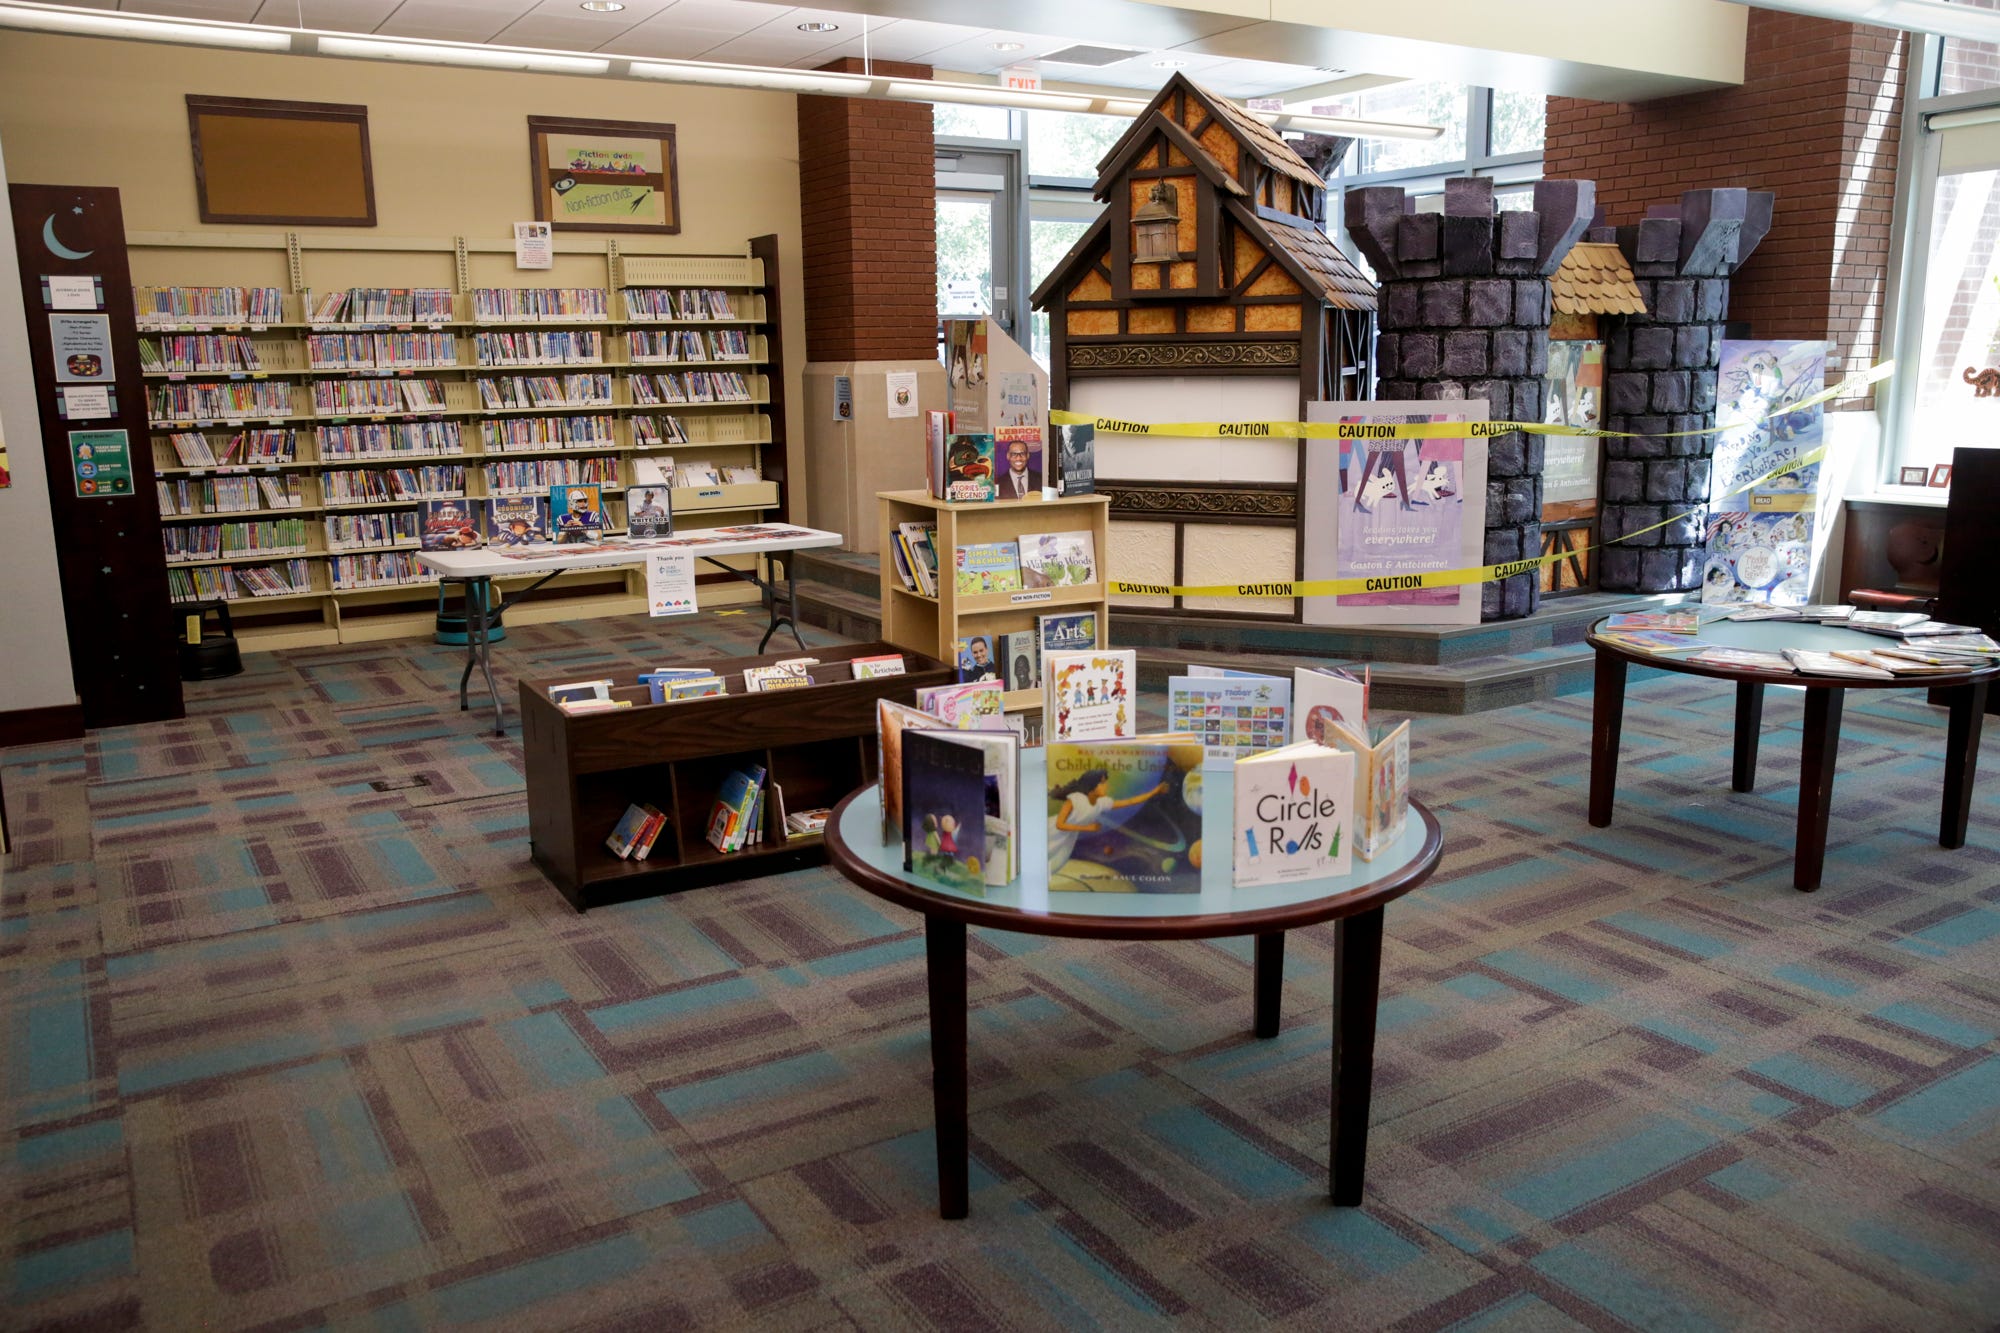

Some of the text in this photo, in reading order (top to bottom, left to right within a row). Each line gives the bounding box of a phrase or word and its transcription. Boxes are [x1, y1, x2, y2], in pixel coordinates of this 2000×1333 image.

[578, 149, 632, 160] Fiction dvds
[1096, 418, 1150, 434] CAUTION
[1218, 423, 1269, 436] CAUTION
[1338, 425, 1396, 439] CAUTION
[1471, 423, 1523, 436] CAUTION
[951, 484, 979, 492] STORIES
[956, 491, 987, 499] LEGENDS
[491, 511, 539, 524] HOCKEY
[1363, 526, 1395, 536] Reading
[1422, 527, 1438, 535] you
[1364, 534, 1436, 546] everywhere!
[967, 548, 998, 558] SIMPLE
[968, 556, 1013, 566] MACHINES
[1064, 556, 1092, 566] Woods
[1350, 560, 1449, 570] Gaston & Antoinette!
[1118, 559, 1542, 596] CAUTION CAUTION CAUTION CAUTION
[1053, 623, 1087, 641] Arts
[873, 666, 903, 675] Artichoke
[1055, 758, 1092, 772] Child
[1112, 759, 1133, 772] the
[1256, 788, 1335, 823] Circle
